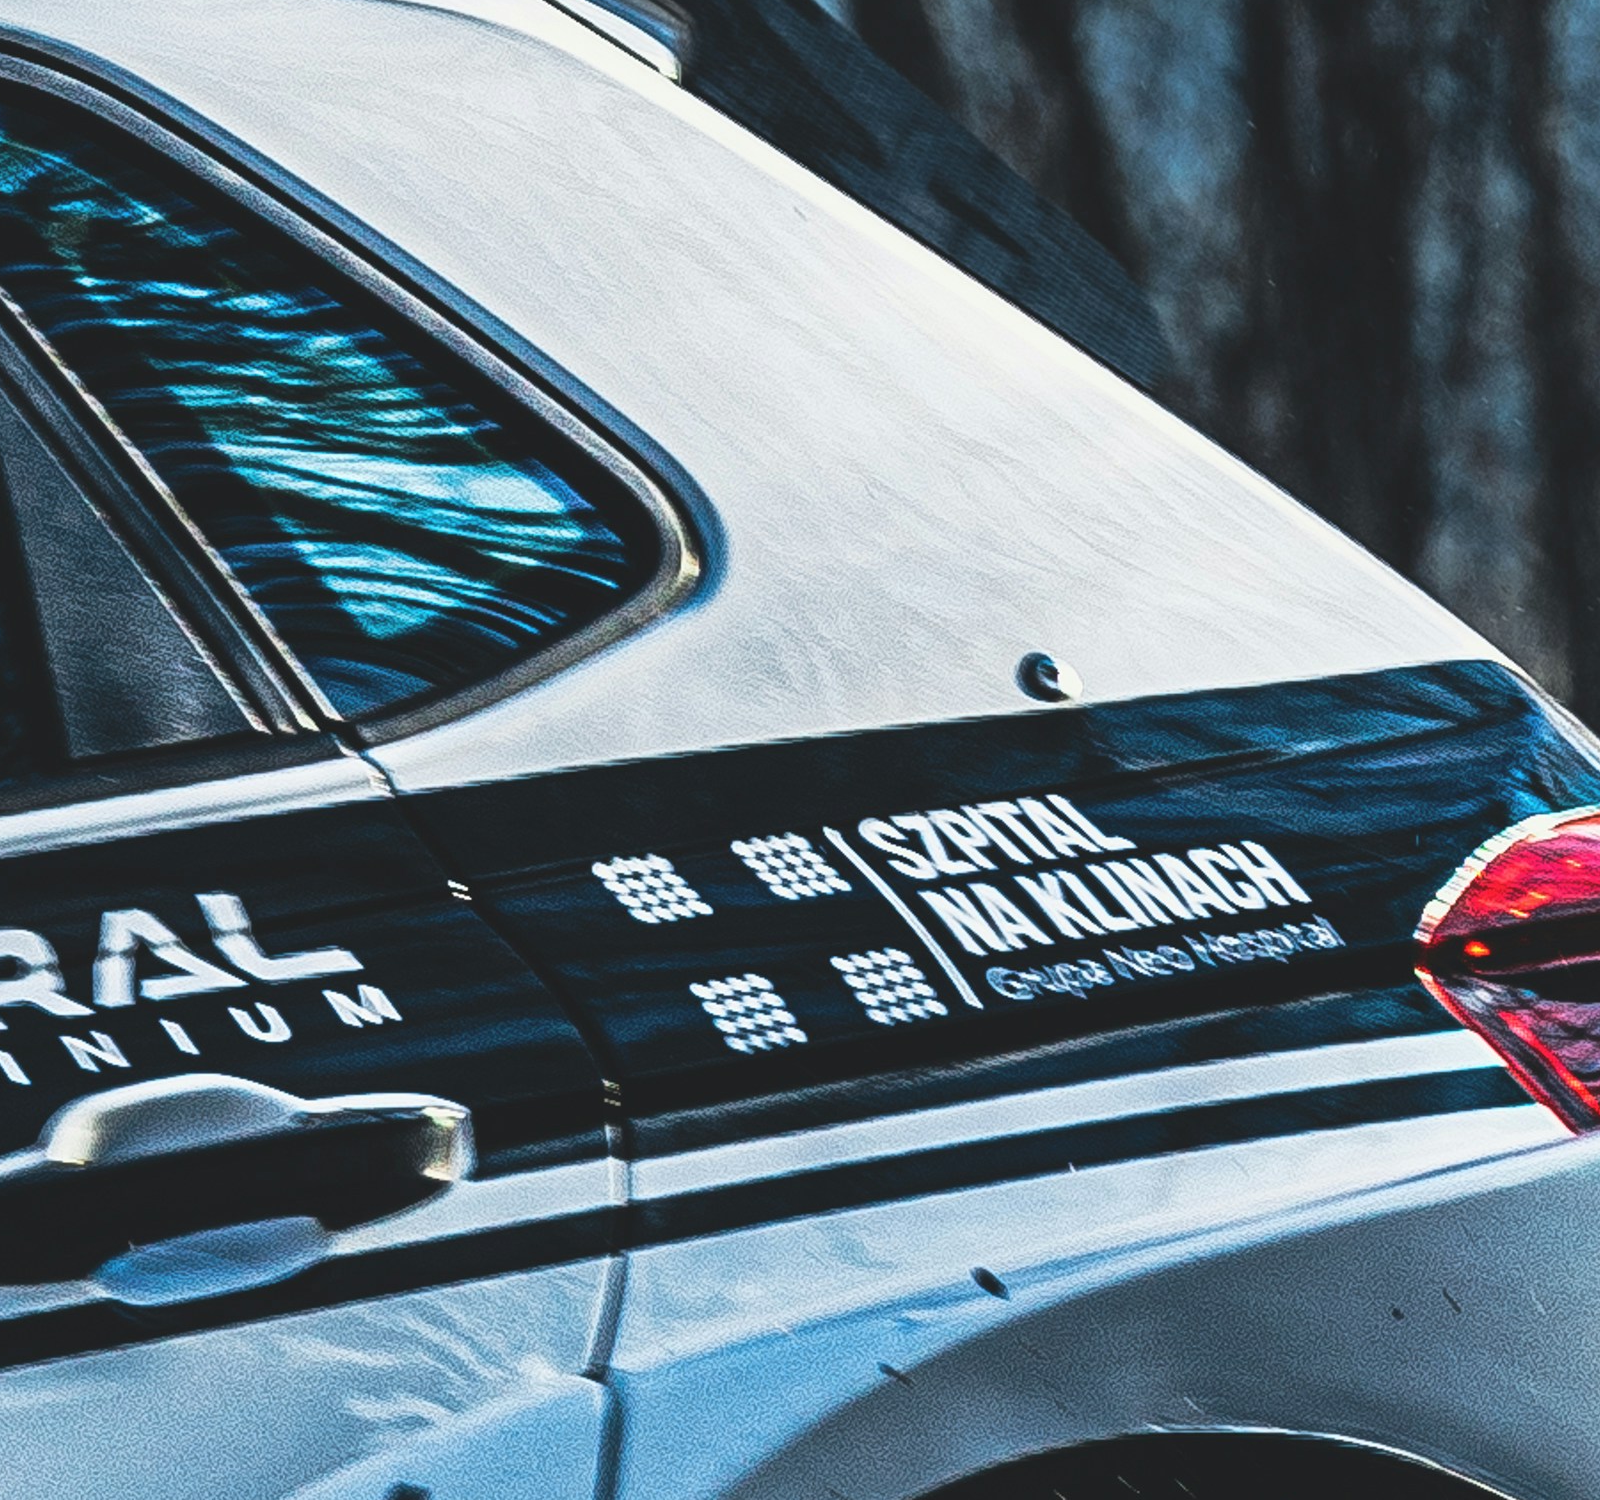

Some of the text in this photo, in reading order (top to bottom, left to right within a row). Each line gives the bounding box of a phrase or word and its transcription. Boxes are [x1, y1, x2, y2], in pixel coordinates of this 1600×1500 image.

[857, 793, 1138, 880] SZPITAL
[916, 840, 1313, 957] NA KLINACH
